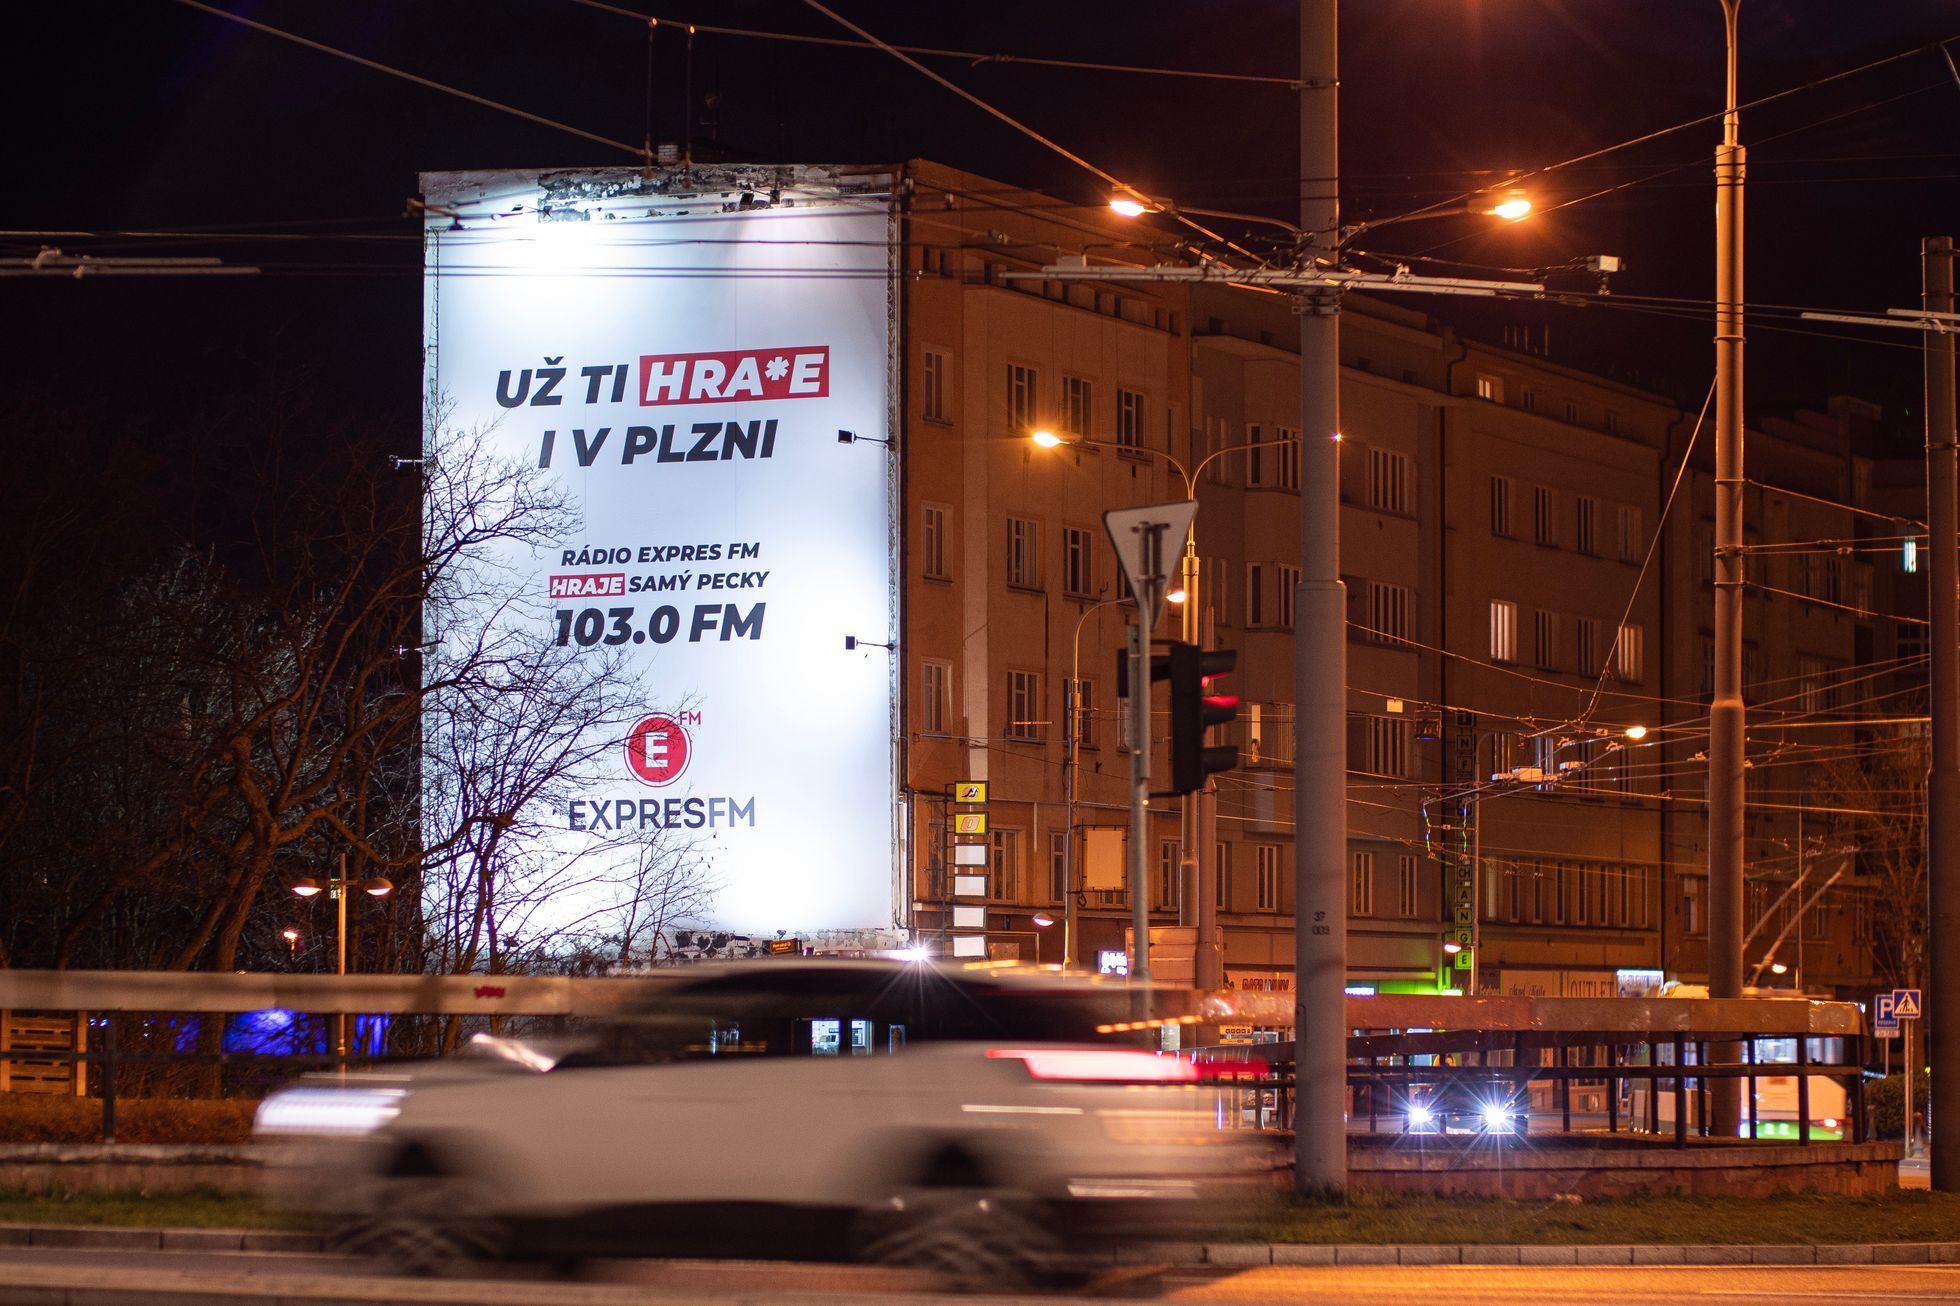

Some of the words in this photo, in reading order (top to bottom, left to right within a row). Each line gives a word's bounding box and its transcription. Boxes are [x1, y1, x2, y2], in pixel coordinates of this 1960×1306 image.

[496, 356, 567, 408] UŽ
[581, 365, 628, 403] TI
[538, 431, 556, 469] I
[573, 428, 611, 467] V
[622, 419, 778, 465] PLZNI
[561, 546, 632, 566] RÁDIO
[638, 544, 721, 563] EXPRES
[728, 543, 760, 560] FM
[551, 577, 624, 596] HRAJE
[628, 569, 693, 593] SAMÝ
[697, 571, 770, 590] PECKY
[555, 604, 680, 647] 103.0
[689, 602, 767, 643] FM
[679, 710, 702, 726] FM
[645, 731, 669, 768] E
[569, 796, 756, 831] EXPRESFM
[1880, 999, 1893, 1019] P
